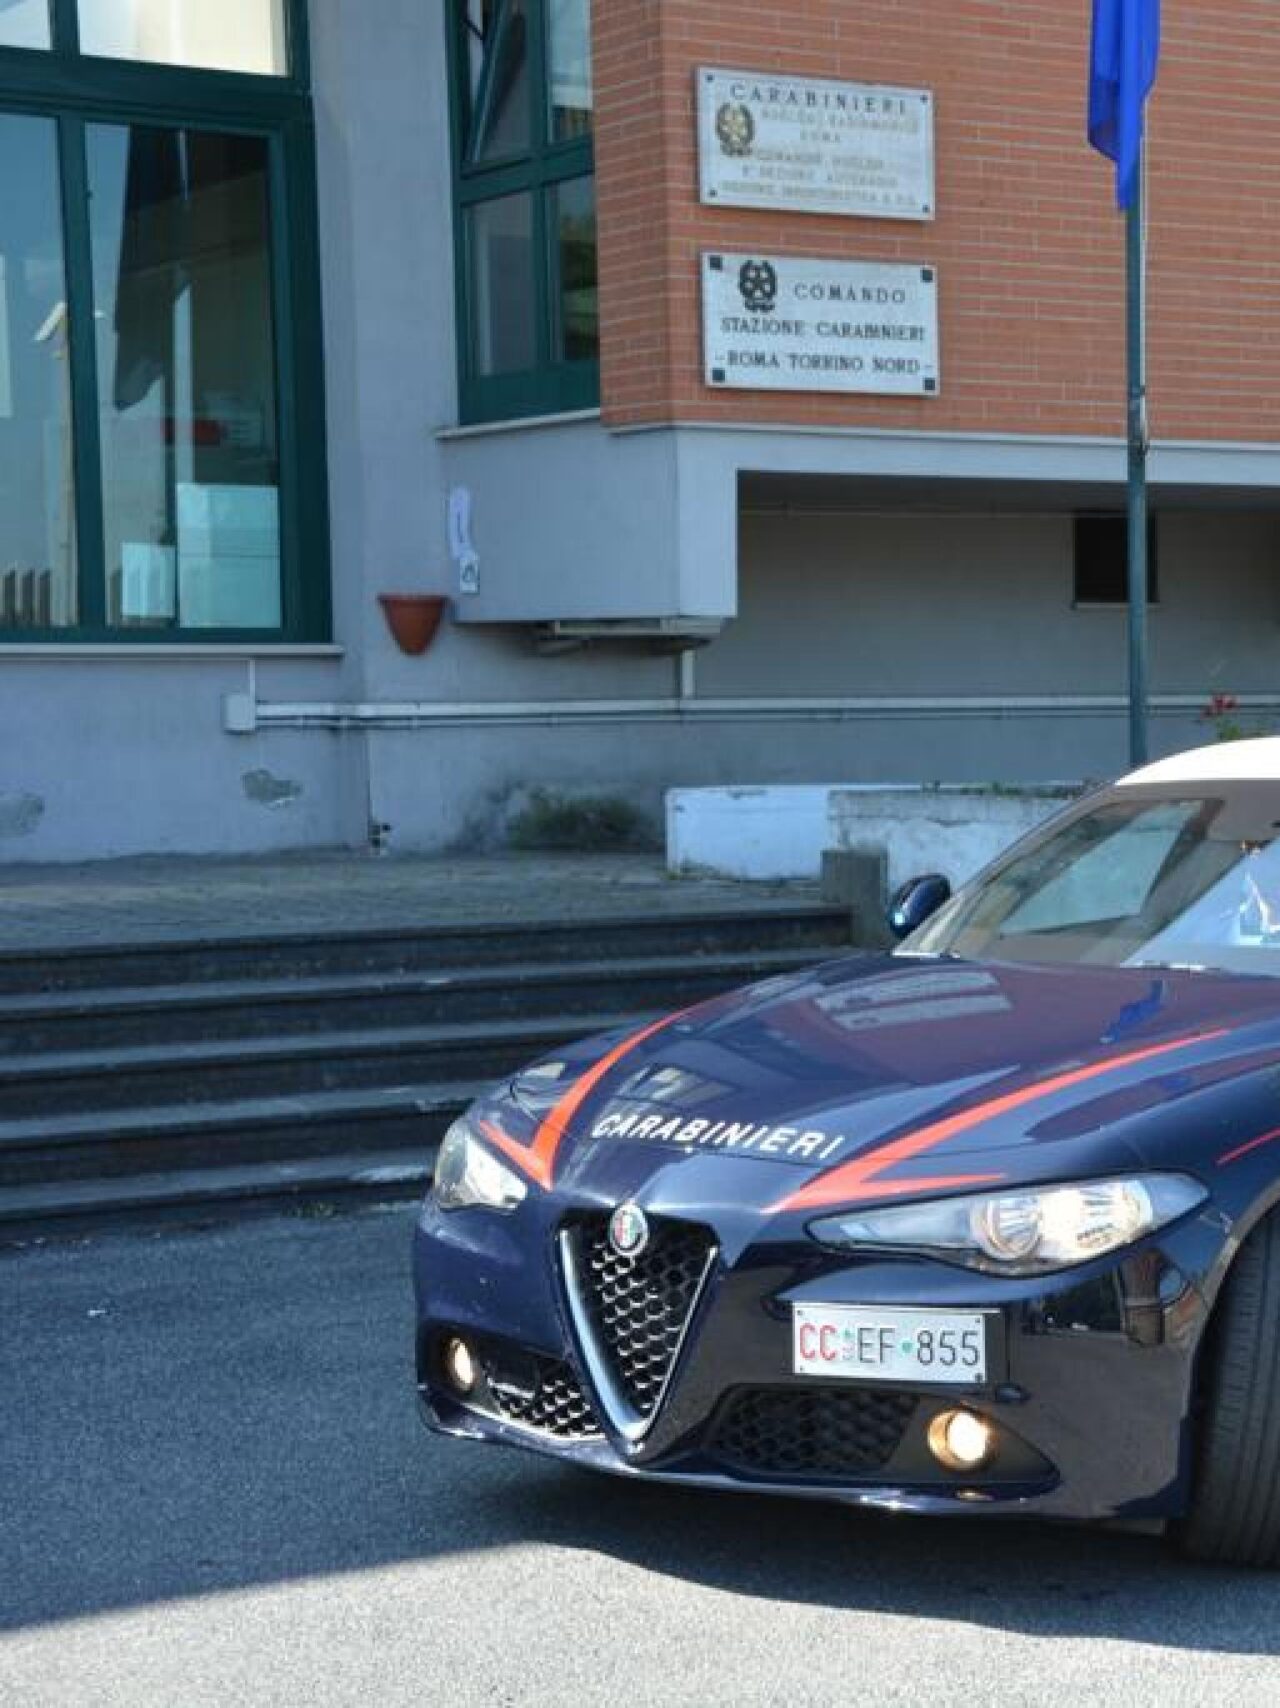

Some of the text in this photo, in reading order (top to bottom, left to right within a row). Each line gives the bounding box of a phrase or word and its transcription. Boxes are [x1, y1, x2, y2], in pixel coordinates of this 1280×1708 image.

[730, 84, 906, 114] CARABINIERI
[794, 283, 906, 304] COMANDO
[720, 317, 925, 341] STAZIONE CARABINIERI
[727, 350, 921, 373] ROMA TORRINO NORD
[592, 1113, 845, 1159] CARABINIERI
[799, 1322, 837, 1361] CC
[857, 1327, 896, 1364] EF
[916, 1329, 979, 1366] 855
